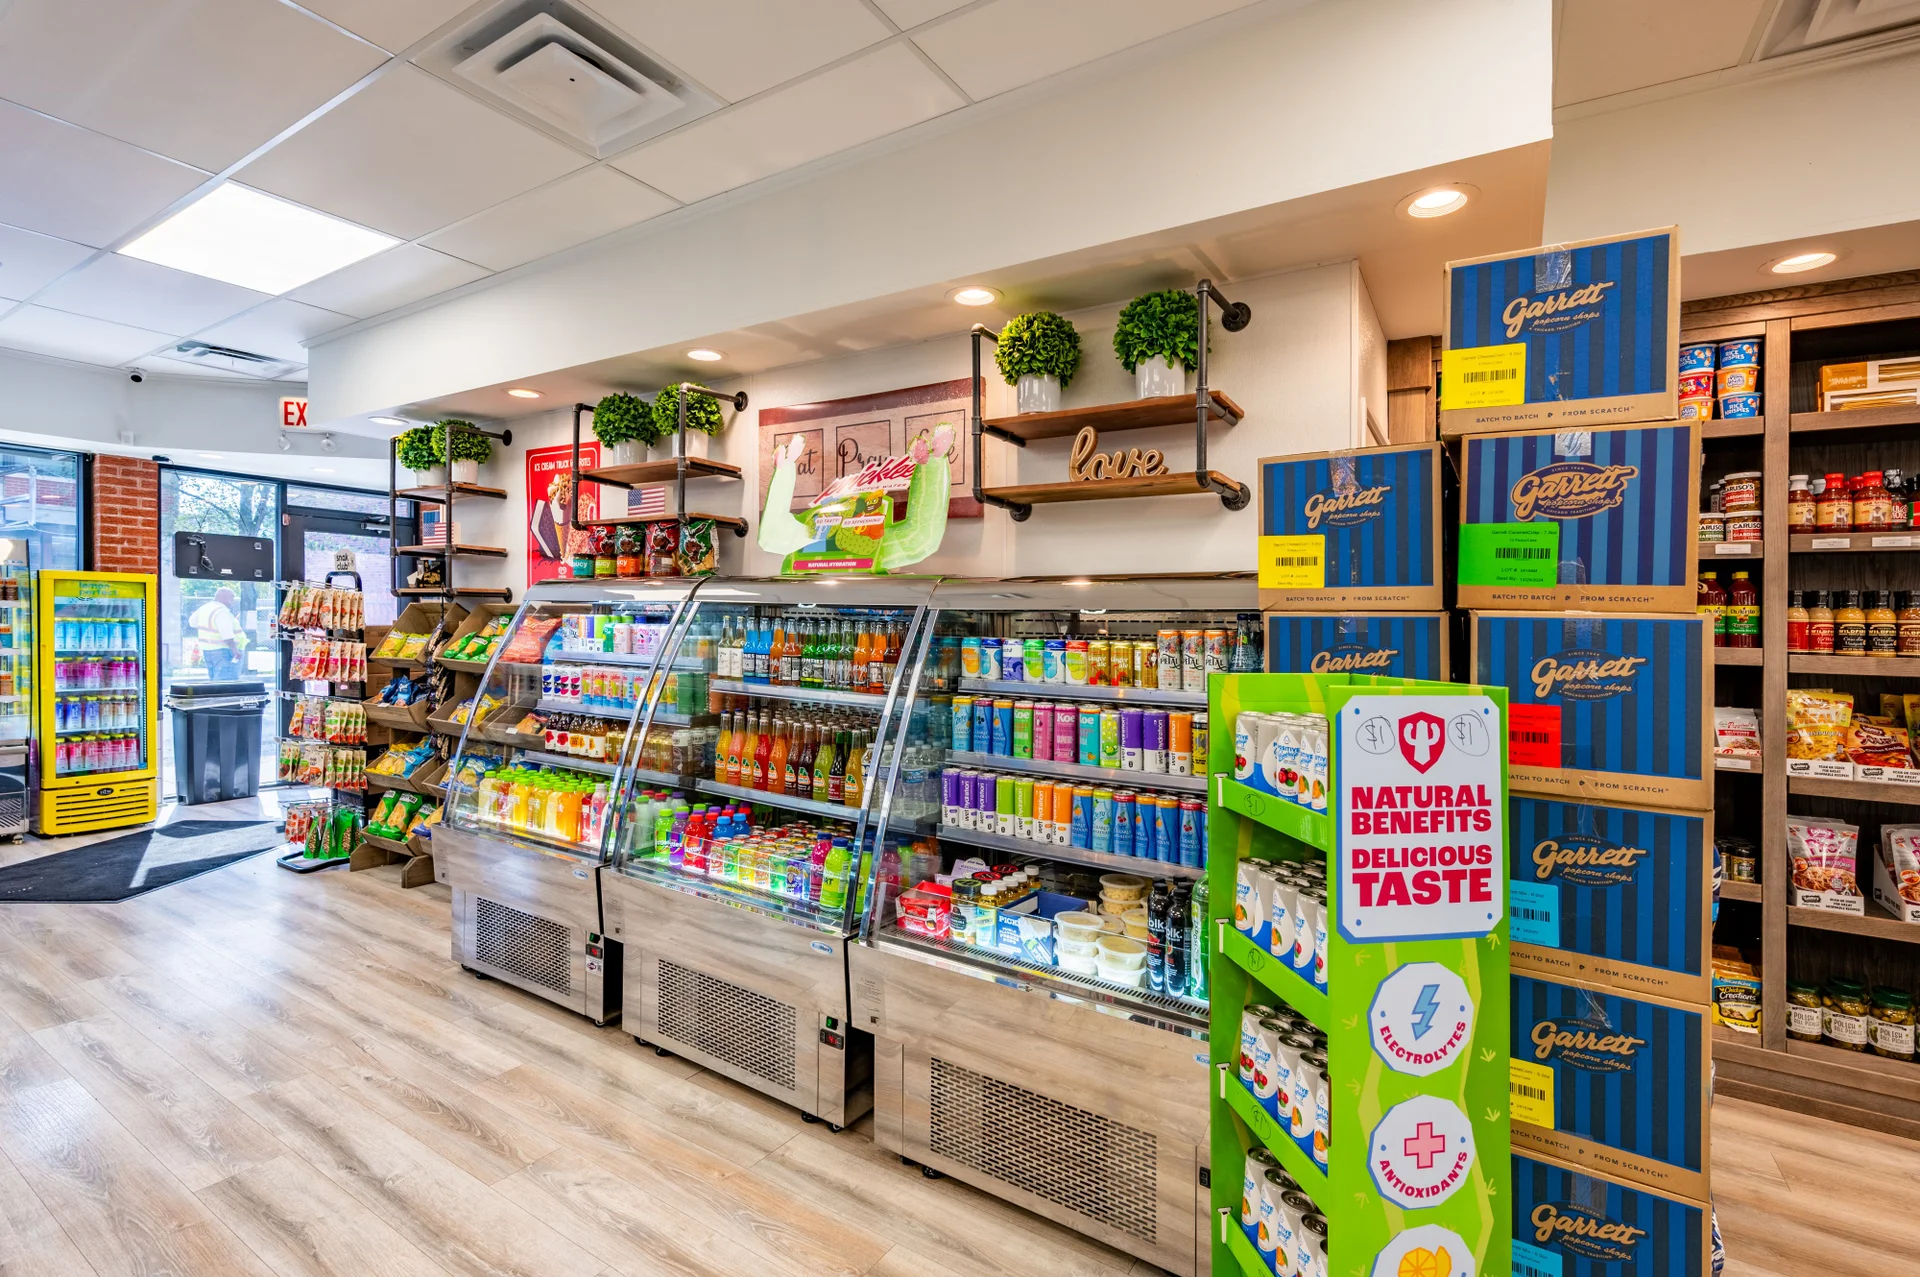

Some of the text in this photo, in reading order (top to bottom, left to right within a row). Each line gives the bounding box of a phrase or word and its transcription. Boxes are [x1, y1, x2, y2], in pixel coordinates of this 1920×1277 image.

[1503, 282, 1614, 339] Garrett
[1532, 312, 1600, 326] popcorn shops
[284, 401, 307, 426] EX
[541, 461, 555, 471] CREAM
[556, 459, 570, 469] TRUCK
[1068, 426, 1169, 482] love
[1512, 467, 1635, 520] Garrett
[1543, 496, 1616, 508] popcorn shops
[1304, 486, 1390, 529] Garrett
[1310, 649, 1398, 673] Garrett
[1531, 656, 1646, 698] Garrett
[1562, 682, 1632, 692] popcorn shops
[1057, 714, 1075, 722] Koe
[1364, 719, 1386, 746] $1
[1456, 719, 1476, 746] $1
[1545, 777, 1570, 785] BATCH
[1351, 784, 1492, 810] NATURAL
[1351, 809, 1492, 835] BENEFITS
[1352, 845, 1492, 869] DELICIOUS
[1532, 841, 1647, 879] Garrett
[1563, 867, 1632, 882] popcorn shops
[1352, 868, 1492, 908] TASTE
[1510, 952, 1530, 960] ATCH
[1545, 958, 1570, 967] BATCH
[1595, 967, 1619, 976] FROM
[1719, 992, 1756, 1000] Creations
[1794, 1012, 1814, 1021] POLISH
[1834, 1019, 1856, 1029] POLISH
[1379, 1021, 1467, 1066] ELECTROLYTES
[1531, 1021, 1645, 1058] Garrett
[1880, 1028, 1902, 1038] POLISH
[1561, 1049, 1632, 1071] popcorn shops
[1511, 1129, 1530, 1138] ATCH
[1545, 1138, 1570, 1150] BATCH
[1594, 1153, 1619, 1165] FROM
[1379, 1151, 1468, 1199] ANTIOXIDANTS
[1531, 1204, 1645, 1245] Garrett
[1562, 1235, 1632, 1261] popcorn shops
